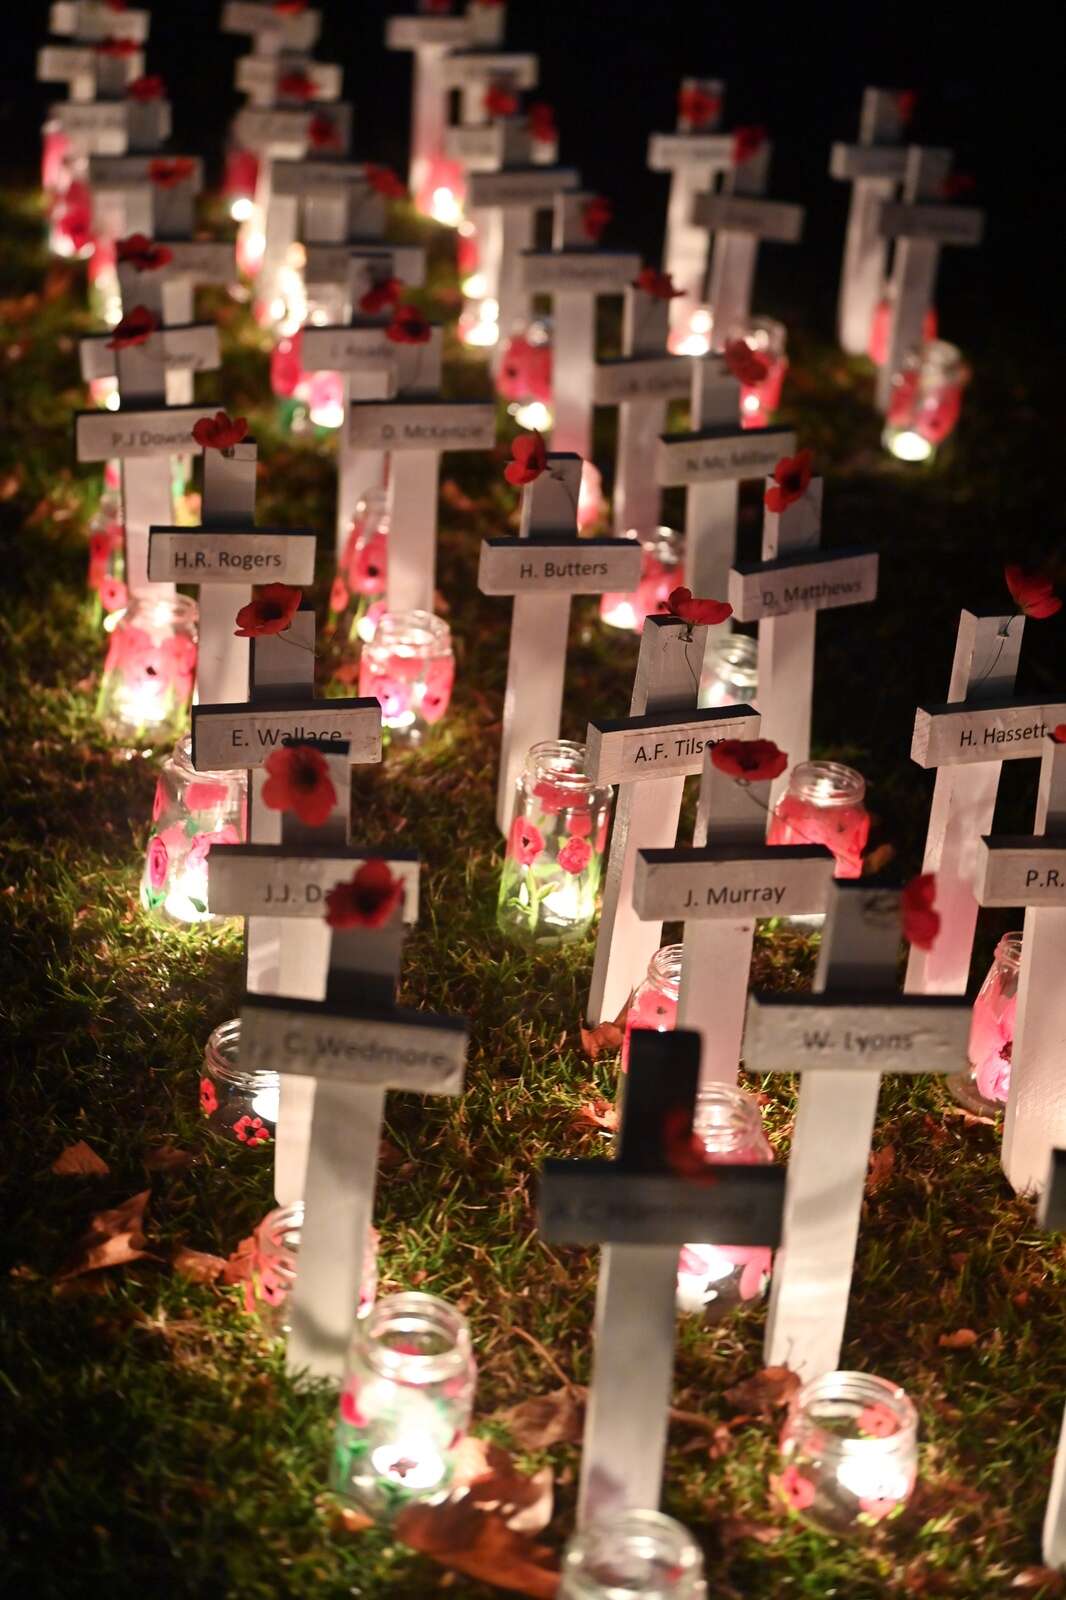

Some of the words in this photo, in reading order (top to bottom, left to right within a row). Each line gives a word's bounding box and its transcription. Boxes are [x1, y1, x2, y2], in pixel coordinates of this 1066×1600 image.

[174, 551, 212, 568] H.R.
[218, 551, 282, 571] Rogers
[519, 563, 538, 579] H.
[543, 561, 608, 578] Butters
[783, 579, 863, 604] Matthews
[231, 728, 249, 747] E.
[257, 726, 343, 747] Wallace
[959, 730, 977, 748] H.
[983, 721, 1047, 745] Hassett
[634, 742, 669, 765] A.F.
[1025, 869, 1066, 888] P.R.
[262, 883, 297, 904] J.J.
[683, 889, 699, 908] J.
[706, 885, 787, 906] Murray
[316, 1034, 450, 1067] Wedmore
[802, 1031, 836, 1051] W.
[843, 1031, 914, 1054] Lyons
